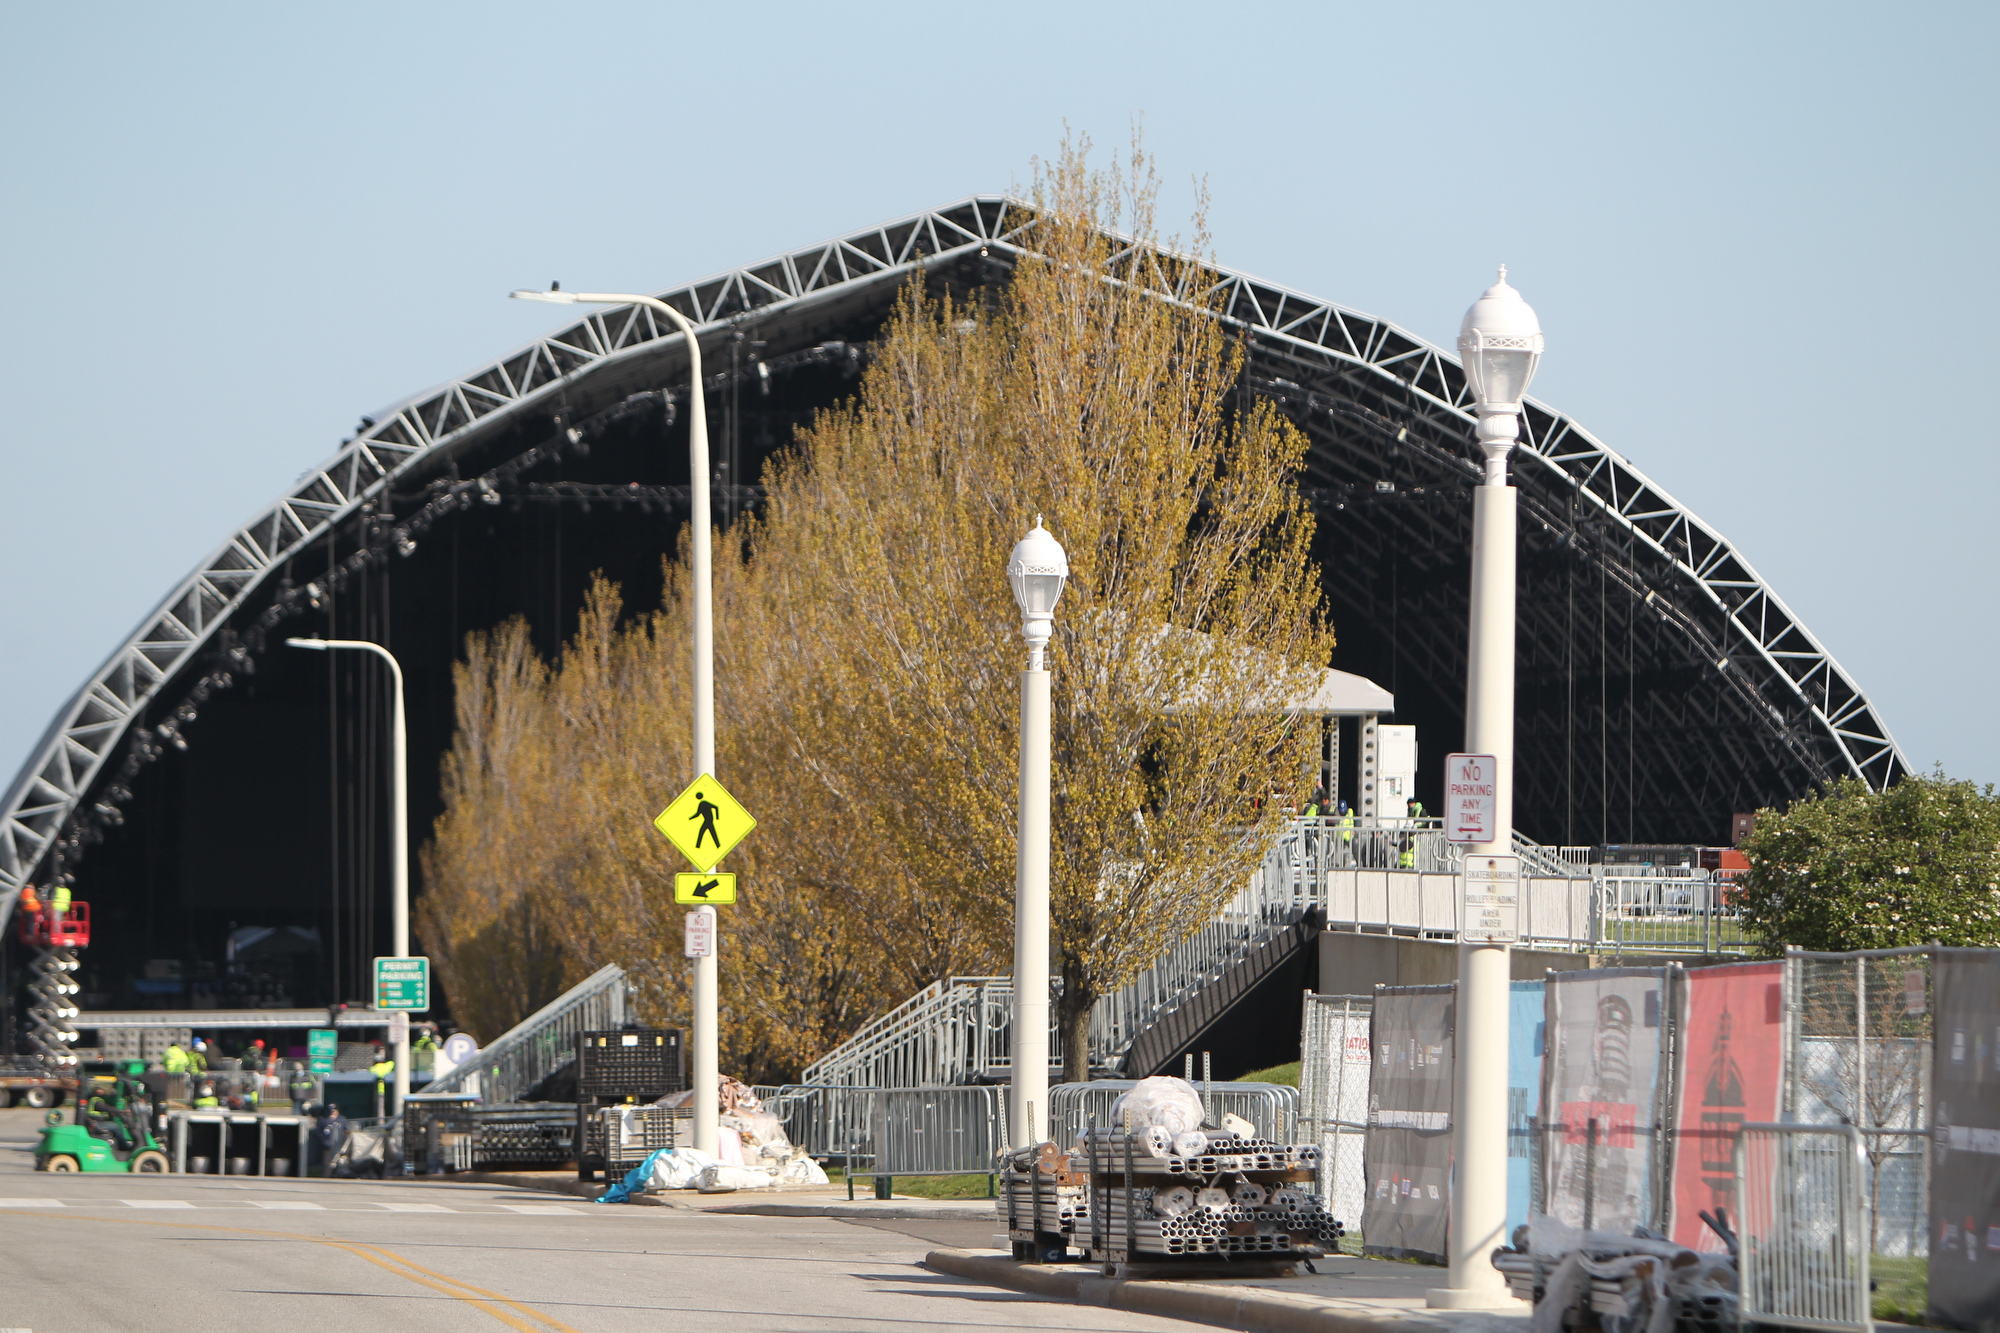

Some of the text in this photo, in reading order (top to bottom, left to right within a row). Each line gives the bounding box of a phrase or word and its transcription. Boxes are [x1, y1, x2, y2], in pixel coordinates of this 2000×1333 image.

[1462, 765, 1481, 781] NO
[1451, 783, 1492, 796] PARKING
[1461, 799, 1481, 810] ANY
[1460, 812, 1482, 824] TIME
[1467, 870, 1517, 880] SKATEBOARDING
[1487, 885, 1496, 893] NO
[1482, 909, 1500, 917] AREA
[694, 917, 705, 926] NO
[1479, 919, 1502, 927] UNDER
[382, 961, 421, 971] PERMIT
[379, 971, 424, 981] PARKING
[452, 1040, 471, 1061] P
